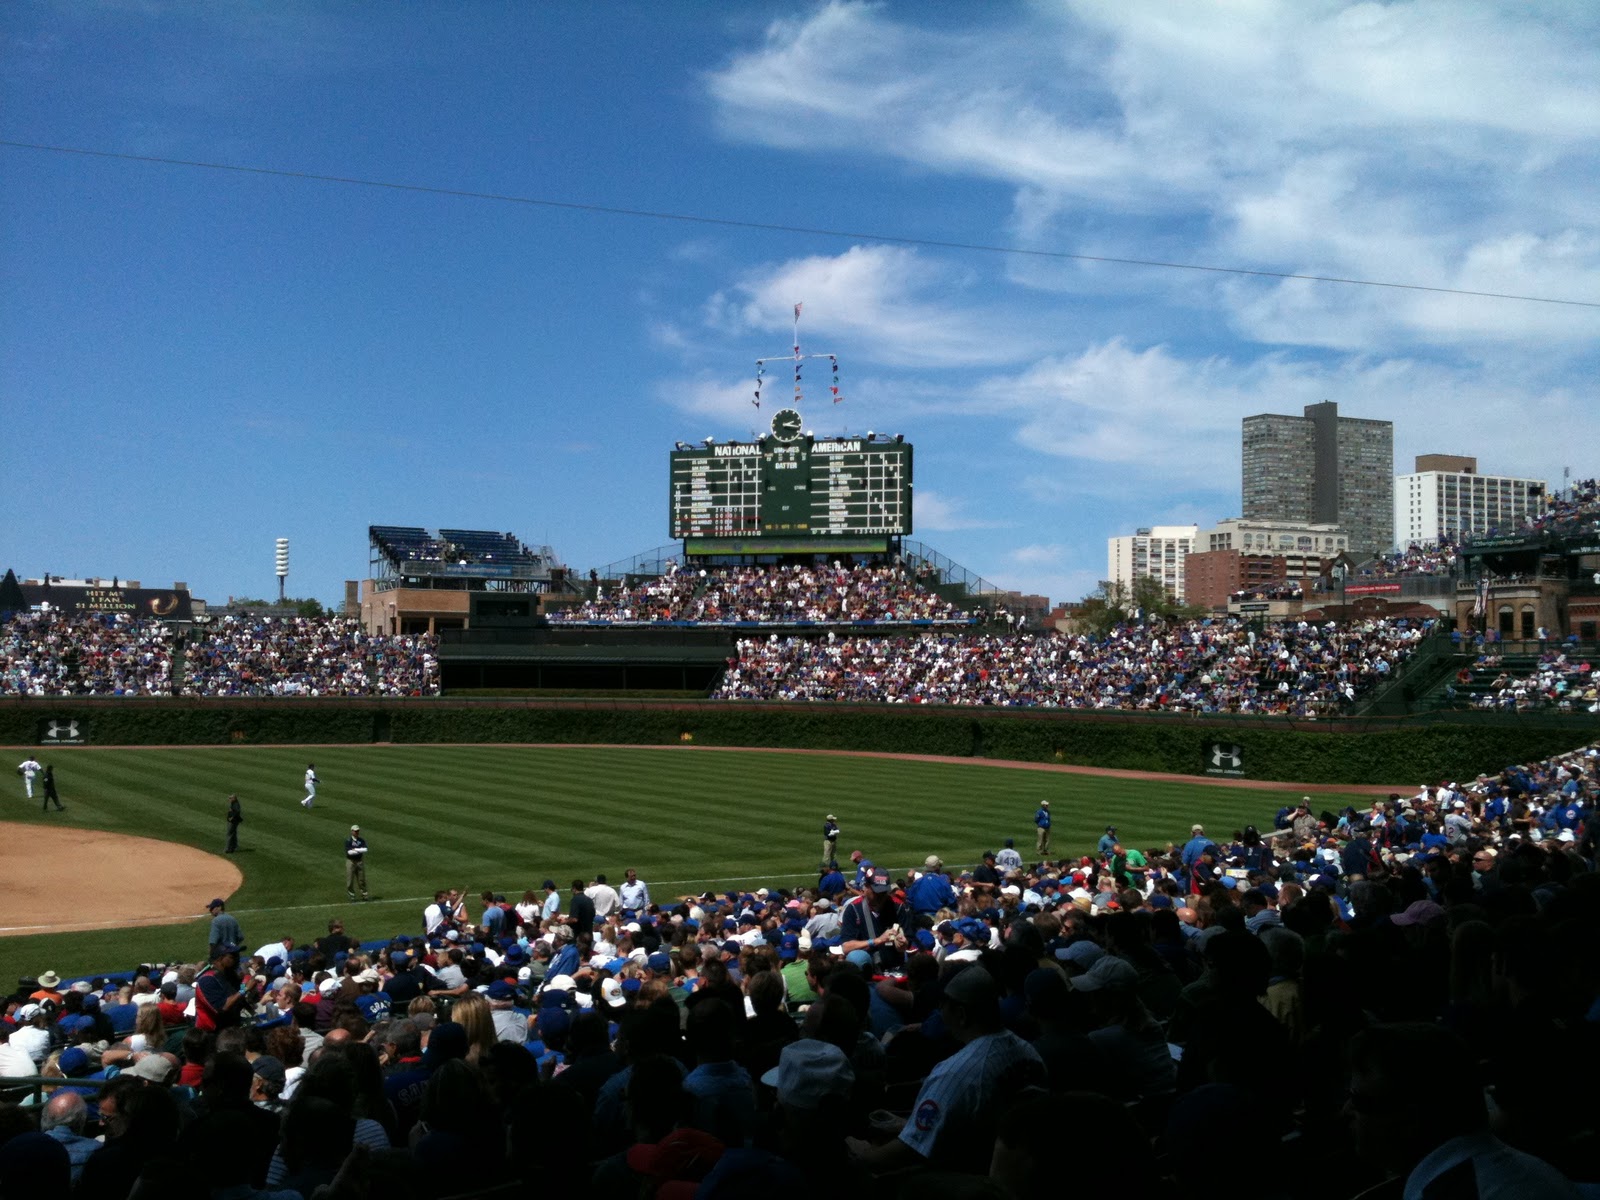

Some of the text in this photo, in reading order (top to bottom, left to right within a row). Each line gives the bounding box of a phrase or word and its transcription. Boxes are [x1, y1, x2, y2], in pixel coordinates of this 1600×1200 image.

[714, 445, 762, 456] NATIONAL
[811, 441, 861, 453] AMERICAN
[1004, 857, 1015, 866] 43
